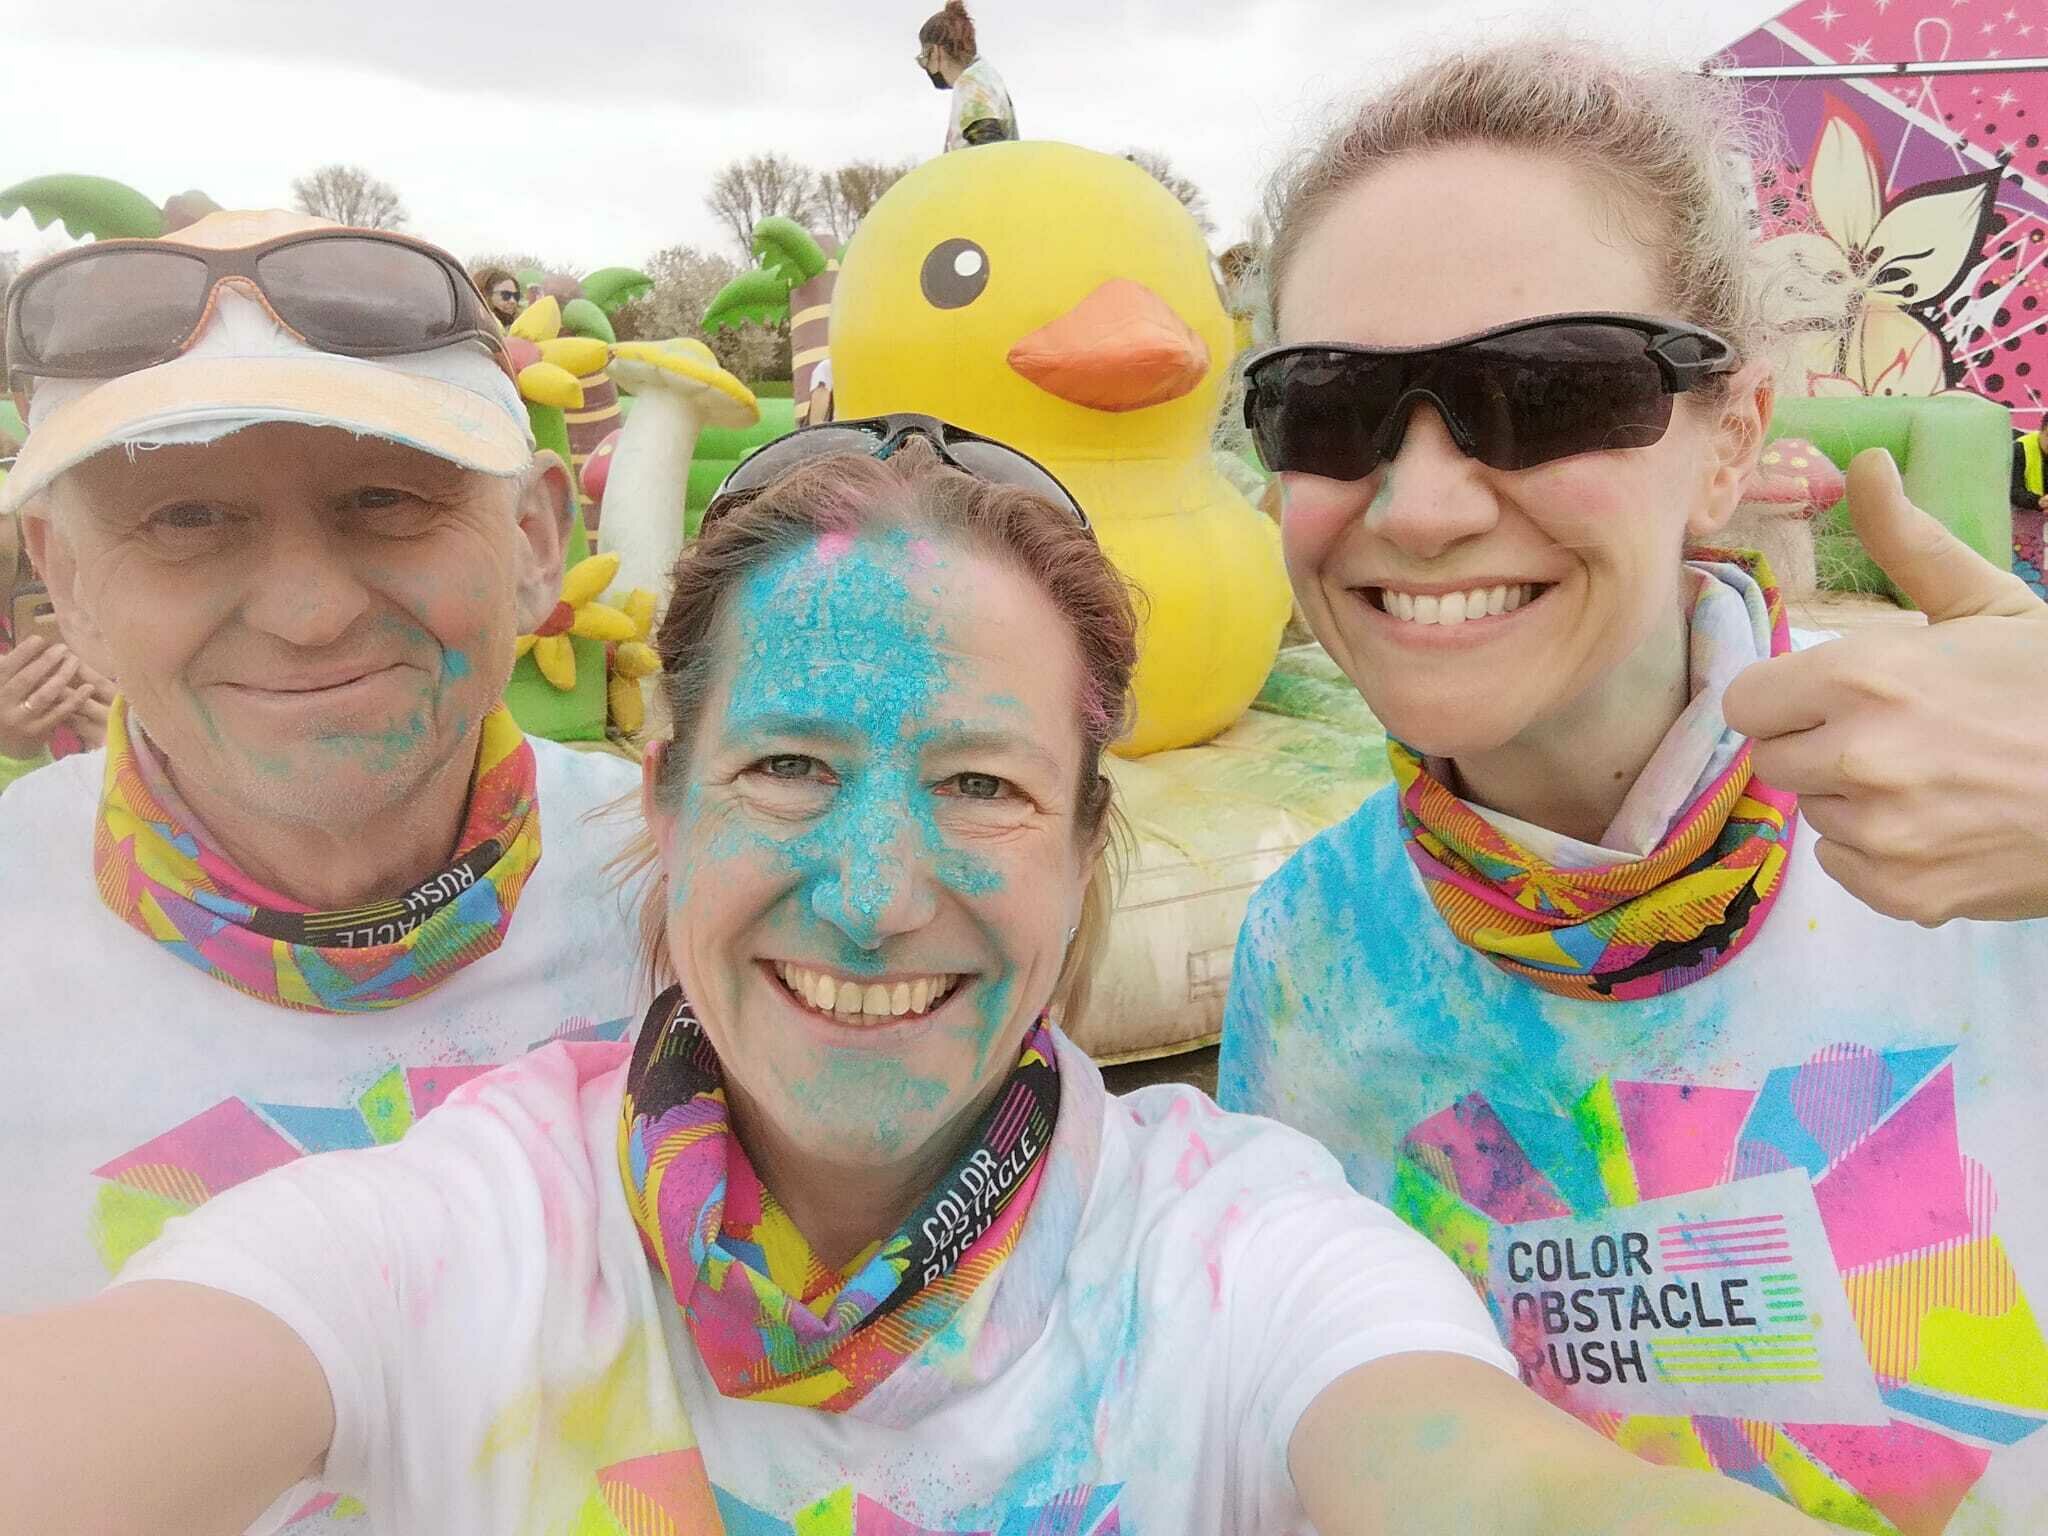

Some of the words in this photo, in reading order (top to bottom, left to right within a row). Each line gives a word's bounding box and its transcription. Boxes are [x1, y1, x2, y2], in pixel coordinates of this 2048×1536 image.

[406, 863, 475, 910] RUSH
[336, 913, 426, 948] ACLE
[922, 1149, 998, 1246] COLOR
[1506, 1231, 1654, 1284] COLOR
[1511, 1278, 1757, 1335] OBSTACLE
